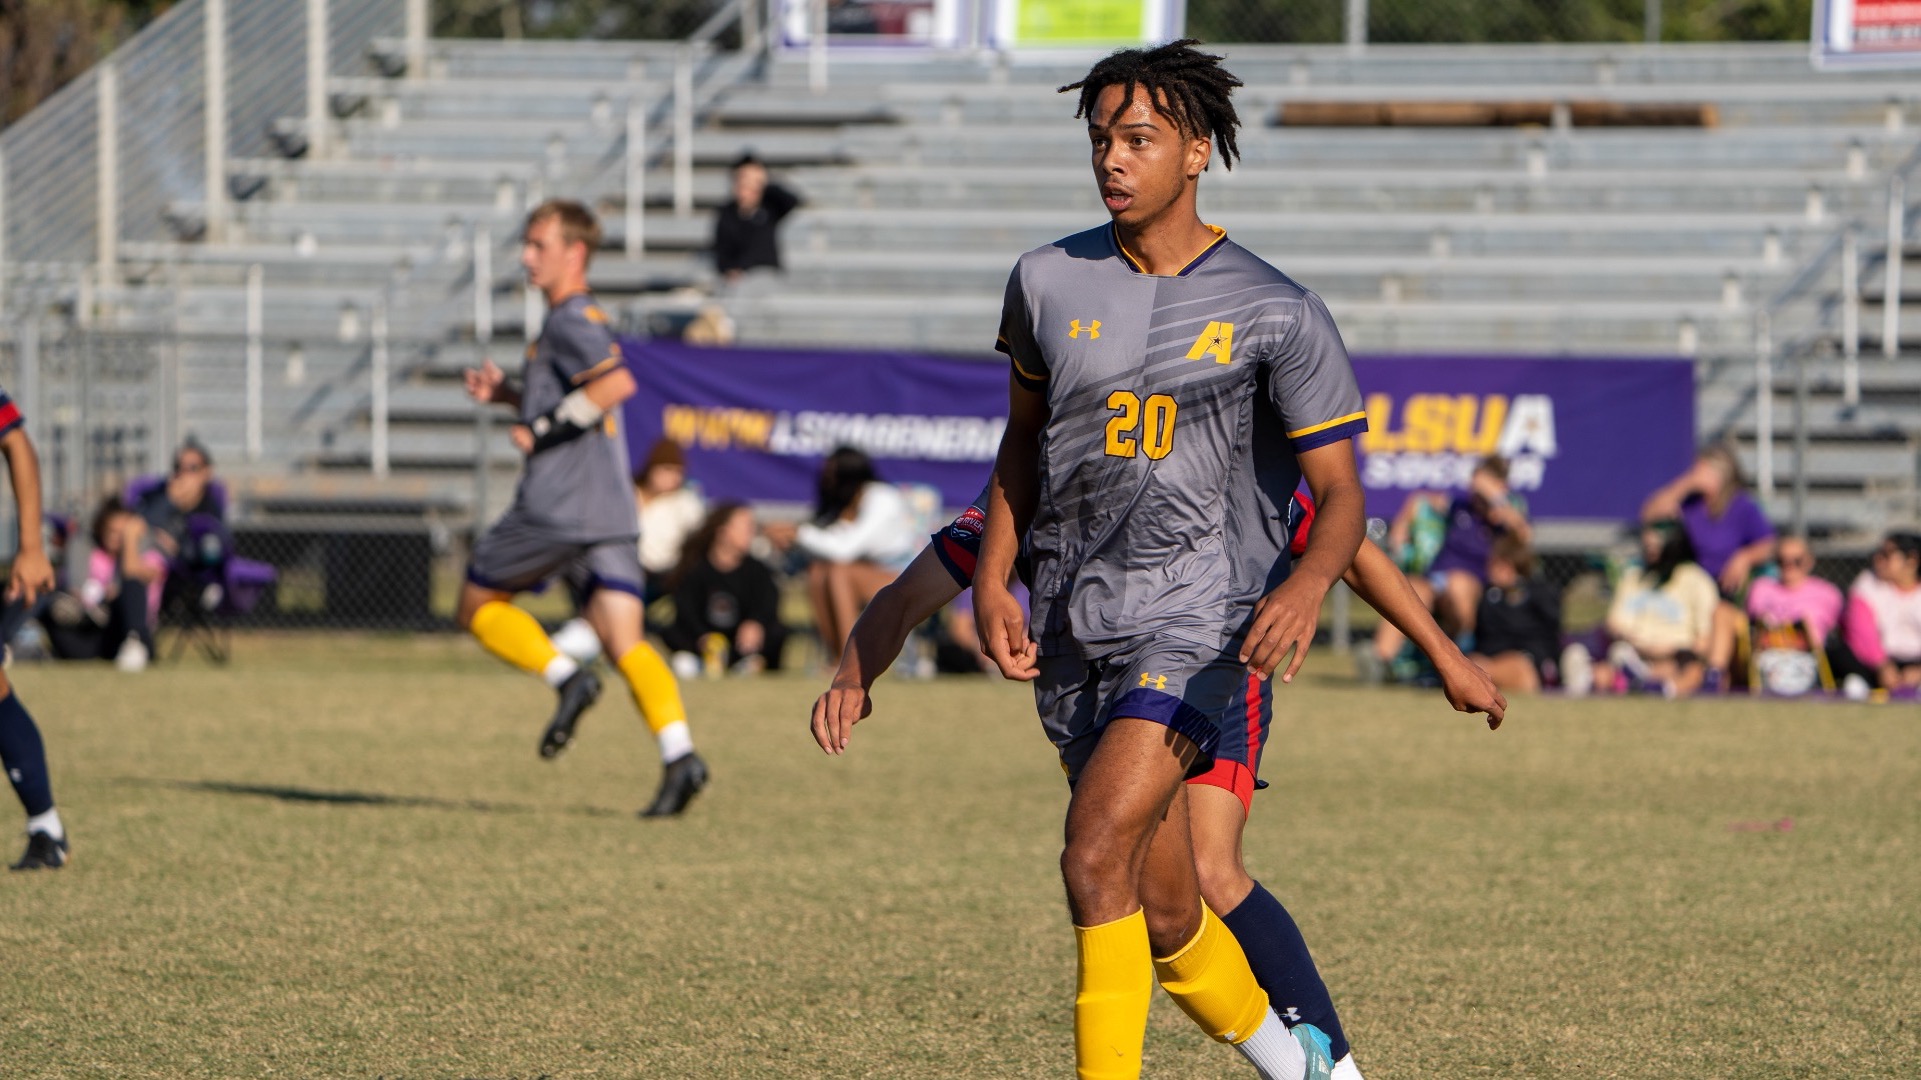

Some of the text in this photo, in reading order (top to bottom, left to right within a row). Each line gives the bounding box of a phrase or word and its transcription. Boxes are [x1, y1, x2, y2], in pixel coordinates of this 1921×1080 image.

[1104, 389, 1178, 460] 20
[1361, 393, 1556, 456] LSUA
[1365, 454, 1545, 490] SOCCR
